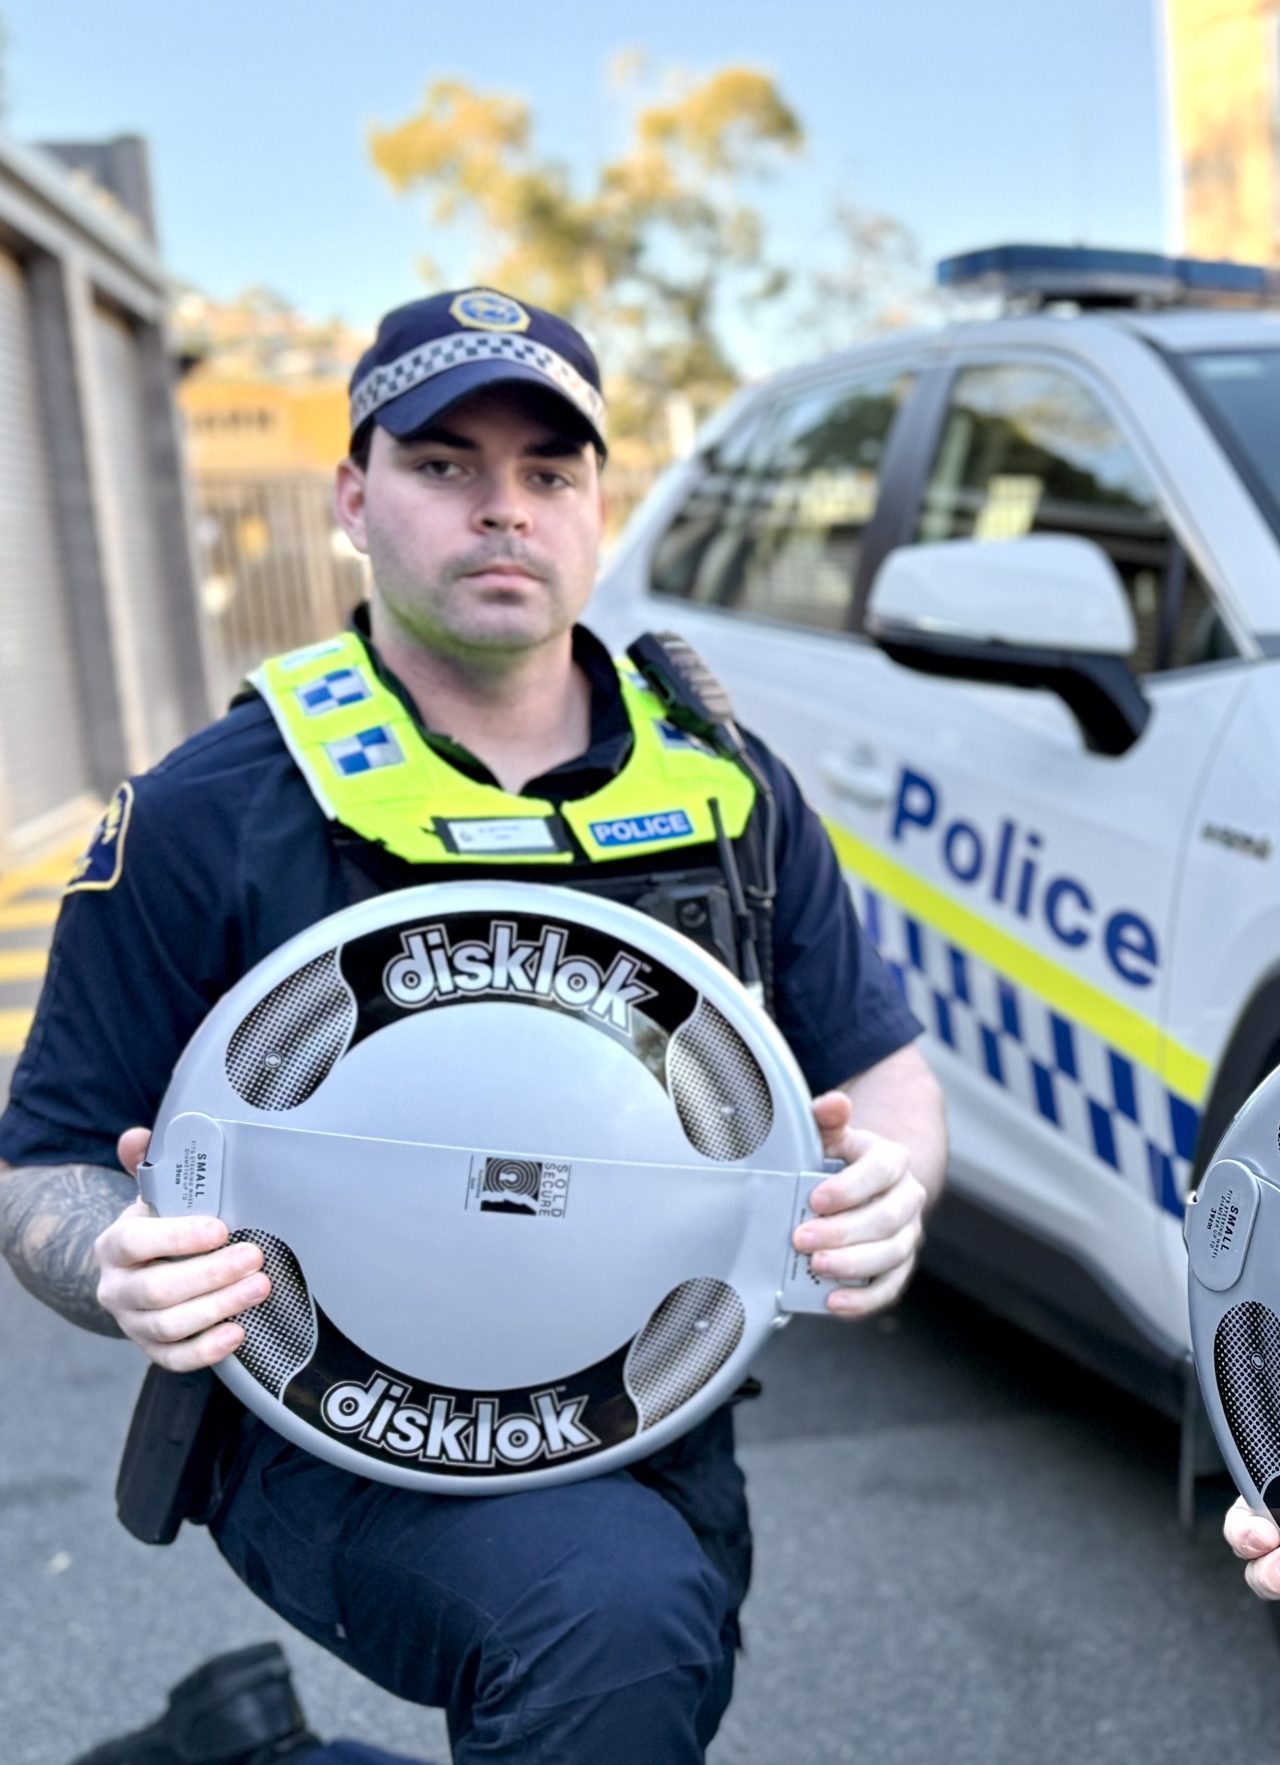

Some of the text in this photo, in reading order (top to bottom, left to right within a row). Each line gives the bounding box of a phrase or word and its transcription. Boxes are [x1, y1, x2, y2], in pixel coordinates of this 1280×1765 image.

[592, 811, 690, 843] POLICE
[889, 764, 1160, 987] Police
[382, 920, 659, 1037] disklok
[195, 1153, 207, 1197] SMALL
[539, 1162, 557, 1217] SECURE
[551, 1164, 569, 1218] SOLD
[1220, 1205, 1239, 1251] SMALL
[320, 1370, 601, 1468] disklok
